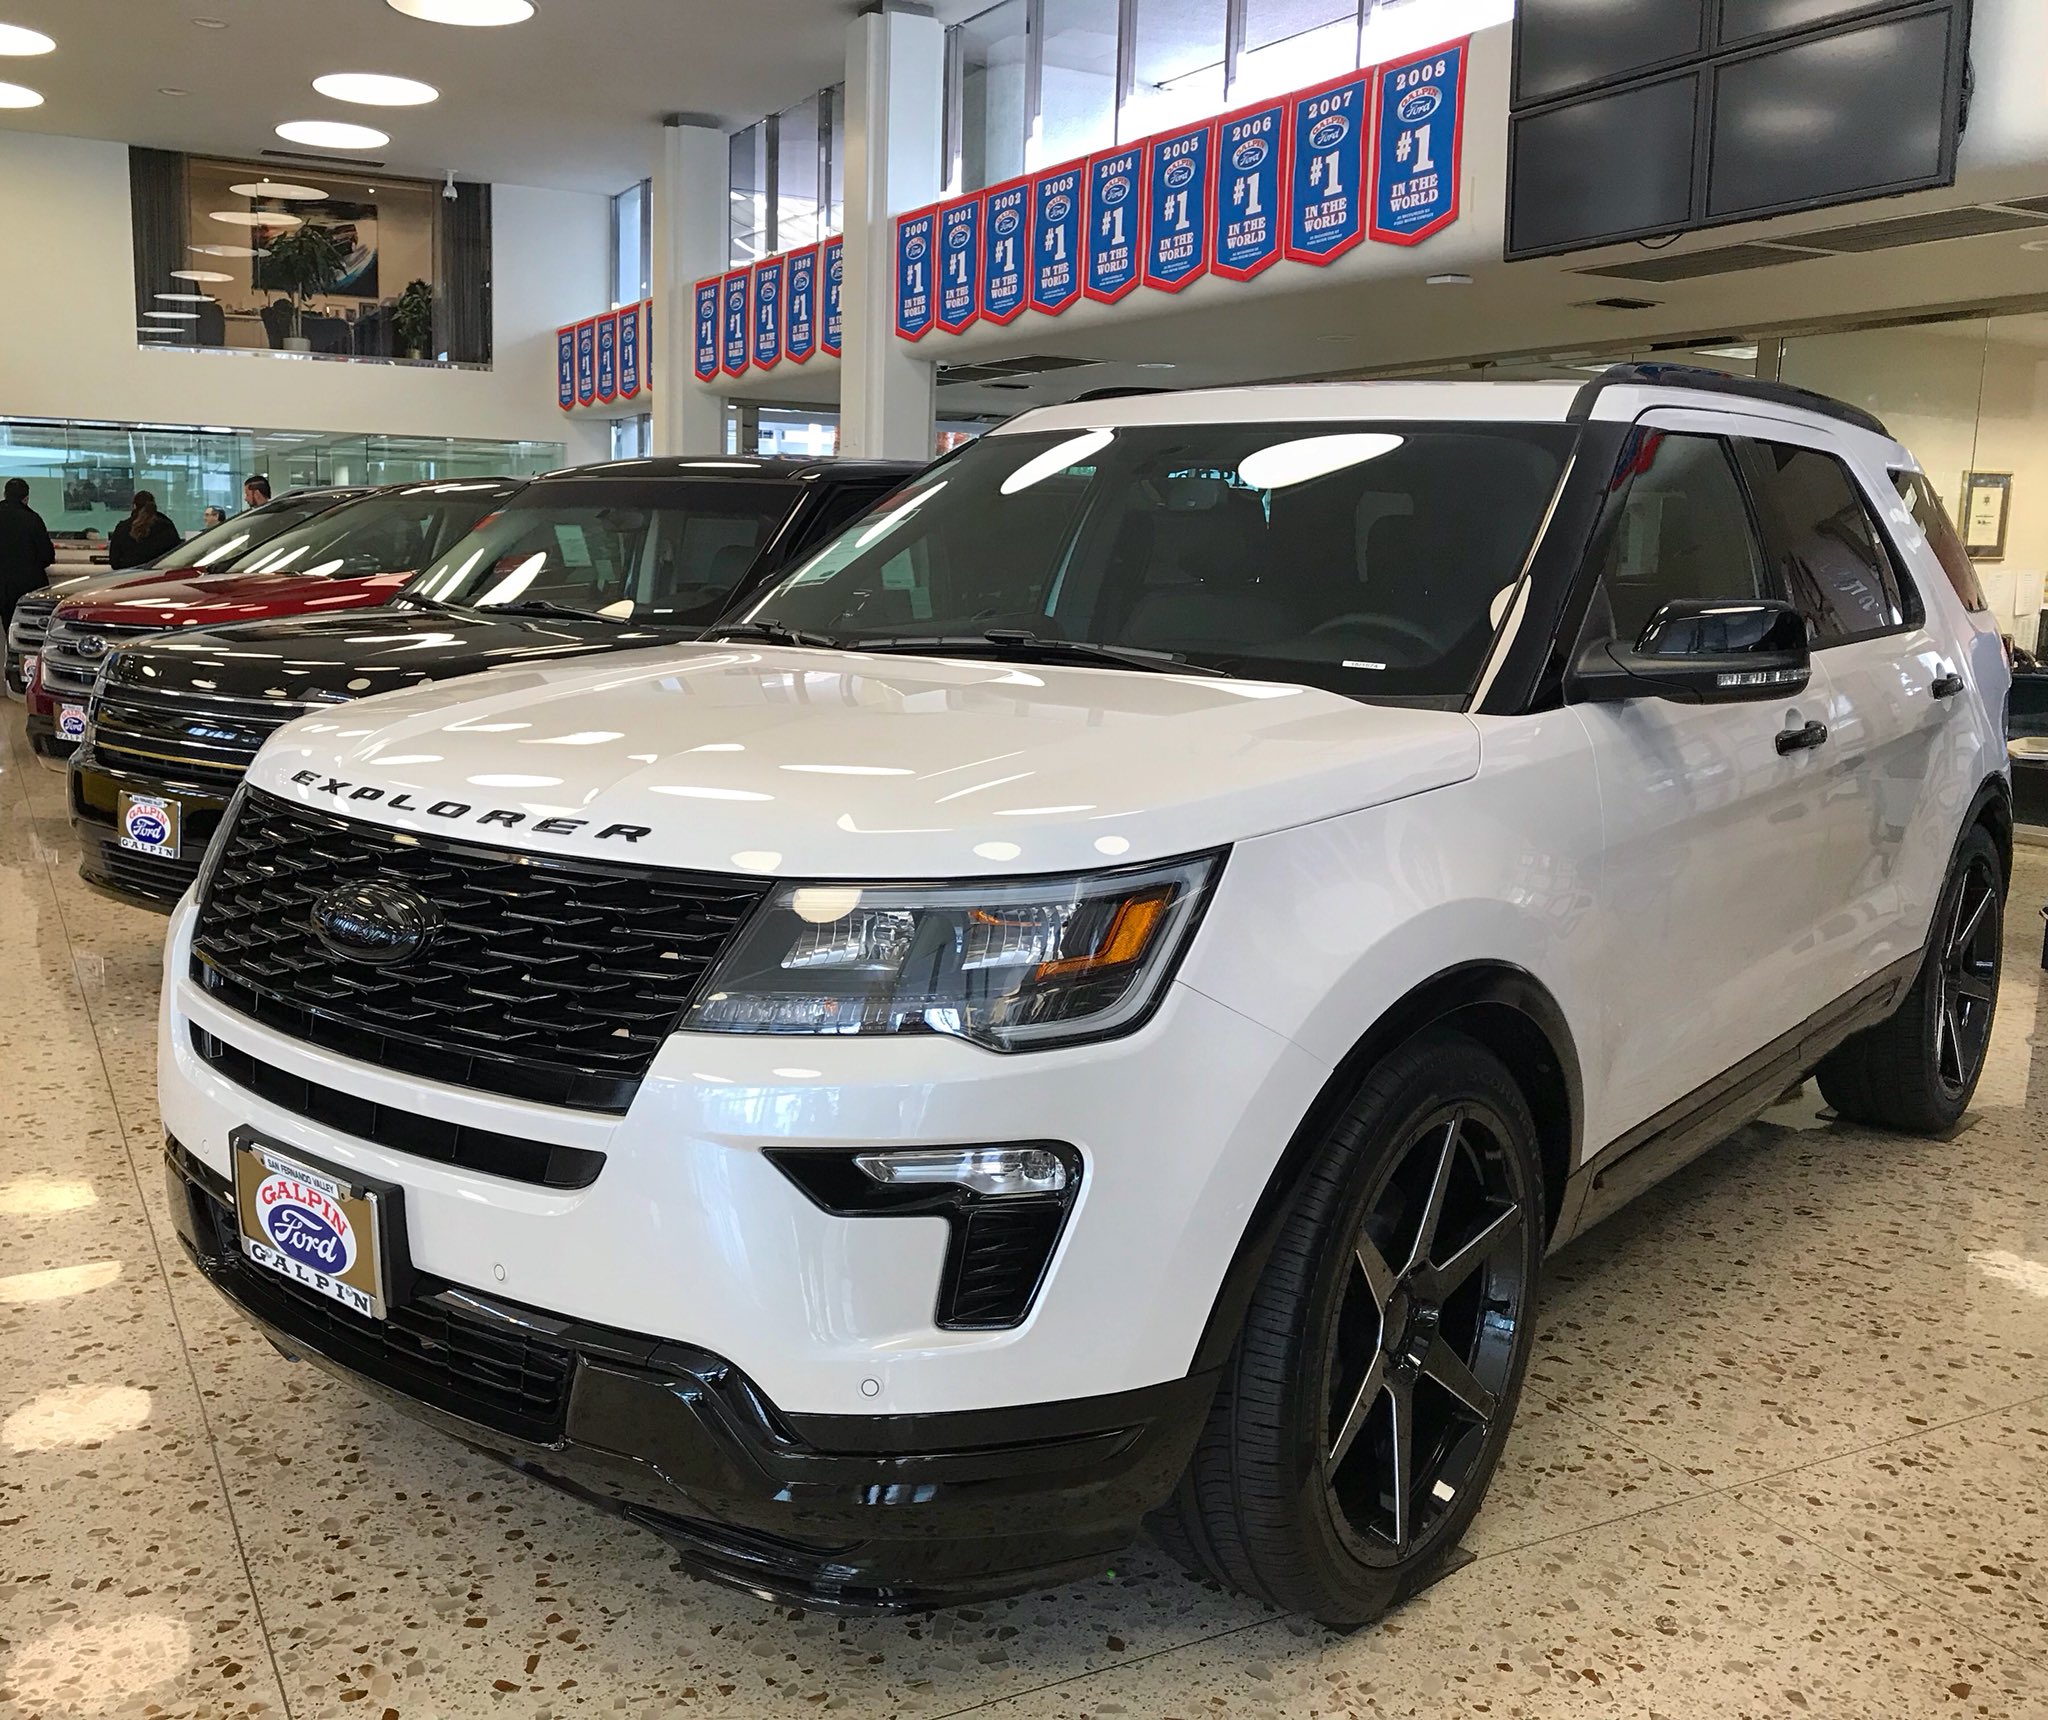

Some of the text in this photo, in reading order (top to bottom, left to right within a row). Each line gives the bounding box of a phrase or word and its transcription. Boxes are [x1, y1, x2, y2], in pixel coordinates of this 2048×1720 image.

[1396, 60, 1445, 90] 2008
[1308, 91, 1353, 119] 2007
[1401, 86, 1439, 108] GALPIN
[1404, 97, 1433, 118] Ford
[1232, 117, 1272, 141] 2006
[1311, 115, 1346, 136] GALPIN
[1317, 125, 1341, 143] Ford
[1163, 137, 1198, 161] 2005
[1235, 138, 1266, 157] GALPIN
[1239, 148, 1261, 165] Ford
[1396, 124, 1434, 174] #1
[1101, 157, 1132, 178] 2004
[1165, 158, 1193, 176] GALPIN
[1170, 167, 1189, 183] Ford
[1310, 151, 1342, 197] #1
[1045, 177, 1073, 196] 2003
[1108, 186, 1124, 199] Ford
[1233, 173, 1261, 215] #1
[1392, 174, 1438, 199] IN THE
[994, 192, 1021, 210] 2002
[1050, 205, 1066, 217] Ford
[1164, 191, 1189, 231] #1
[1305, 198, 1347, 221] IN THE
[1390, 189, 1438, 213] WORLD
[948, 208, 972, 225] 2001
[1000, 219, 1014, 230] Ford
[1102, 207, 1125, 244] #1
[1228, 217, 1265, 237] IN THE
[1304, 212, 1347, 233] WORLD
[905, 221, 928, 237] 2000
[1227, 230, 1265, 249] WORLD
[1044, 224, 1065, 260] #1
[1159, 232, 1193, 251] IN THE
[995, 237, 1014, 272] #1
[1098, 248, 1128, 263] IN THE
[1159, 245, 1193, 263] WORLD
[907, 262, 923, 293] #1
[949, 251, 967, 284] #1
[1042, 263, 1069, 278] IN THE
[1097, 259, 1128, 275] WORLD
[992, 274, 1017, 288] IN THE
[1041, 273, 1069, 288] WORLD
[904, 295, 926, 308] IN THE
[946, 286, 968, 299] IN THE
[991, 284, 1017, 299] WORLD
[794, 294, 807, 321] #1
[904, 305, 926, 318] WORLD
[945, 296, 969, 309] WORLD
[730, 314, 741, 338] #1
[762, 304, 774, 330] #1
[65, 718, 83, 731] Ford
[129, 806, 167, 825] GALPIN
[291, 769, 652, 842] EXPLORER
[133, 818, 162, 839] Ford
[122, 839, 173, 856] GALPIN
[267, 1159, 334, 1194] SAN FERNANDO VALLEY
[262, 1181, 348, 1236] GALPIN
[274, 1209, 338, 1263] Ford
[252, 1244, 370, 1314] GALPIN
